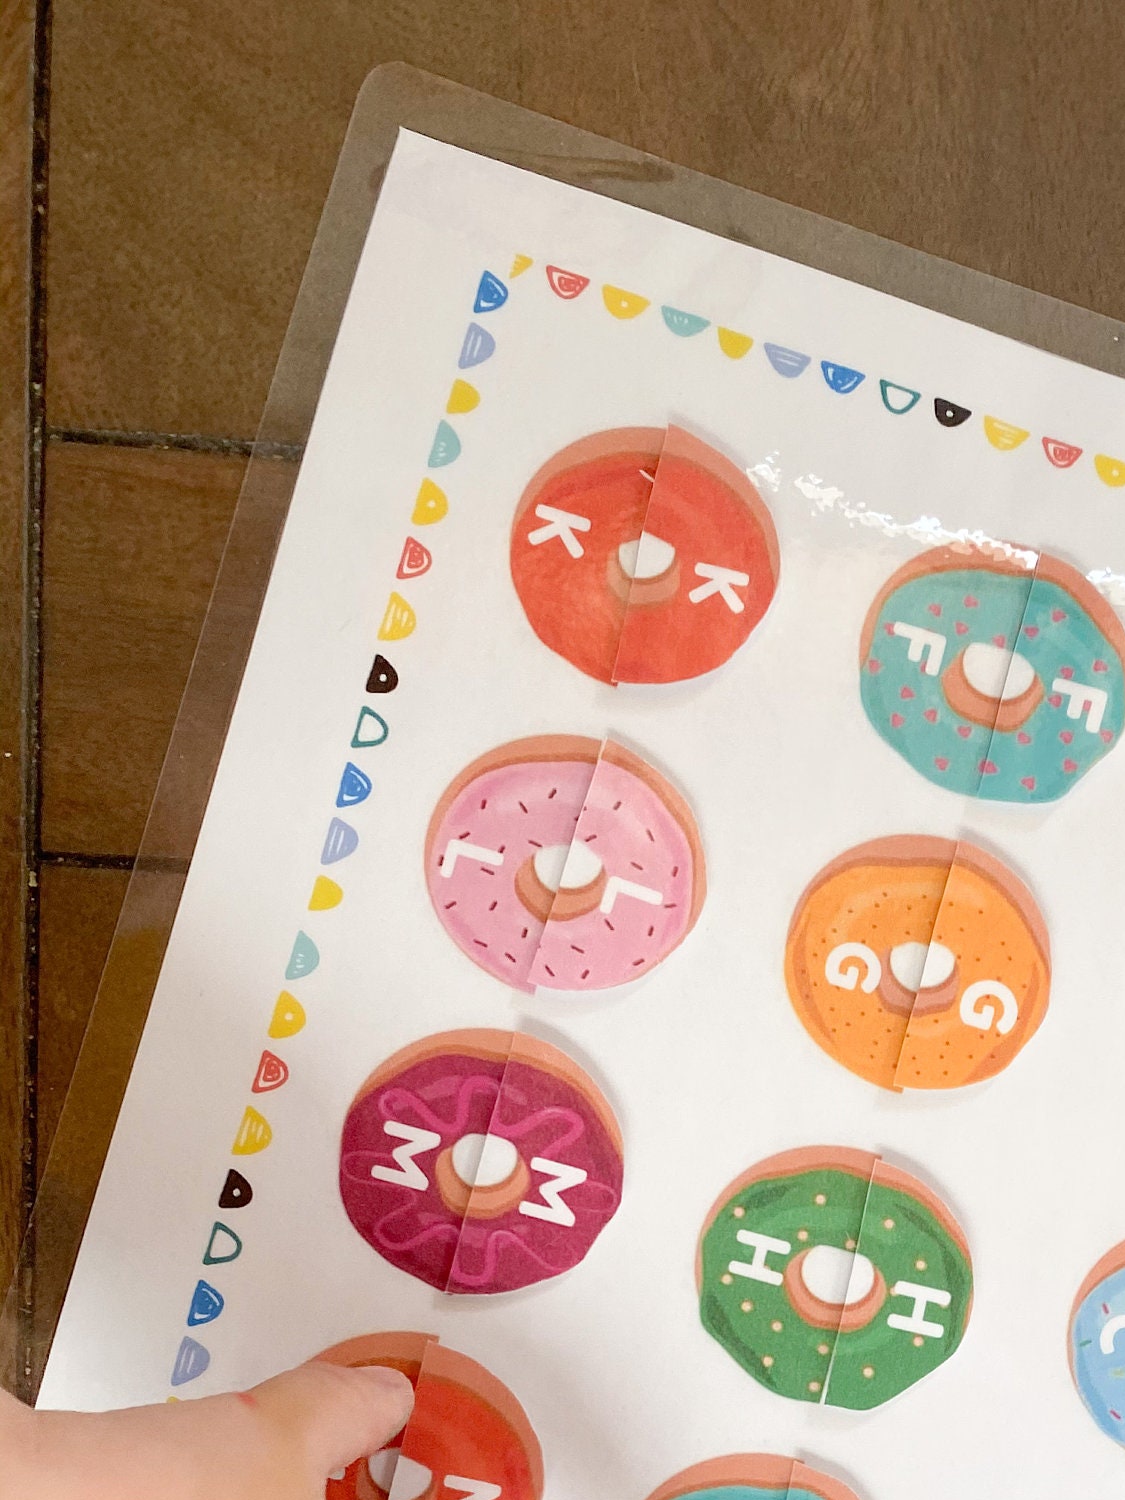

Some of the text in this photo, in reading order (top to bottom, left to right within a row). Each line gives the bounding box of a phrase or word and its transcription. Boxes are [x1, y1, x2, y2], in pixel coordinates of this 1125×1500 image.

[528, 505, 591, 558] K
[689, 563, 750, 613] K
[893, 621, 947, 677] F
[1052, 678, 1108, 734] F
[437, 837, 507, 880] L
[597, 873, 666, 917] L
[825, 942, 882, 993] G
[959, 980, 1018, 1034] G
[371, 1121, 441, 1191] M
[519, 1156, 587, 1227] M
[727, 1228, 792, 1287] H
[886, 1279, 952, 1339] H
